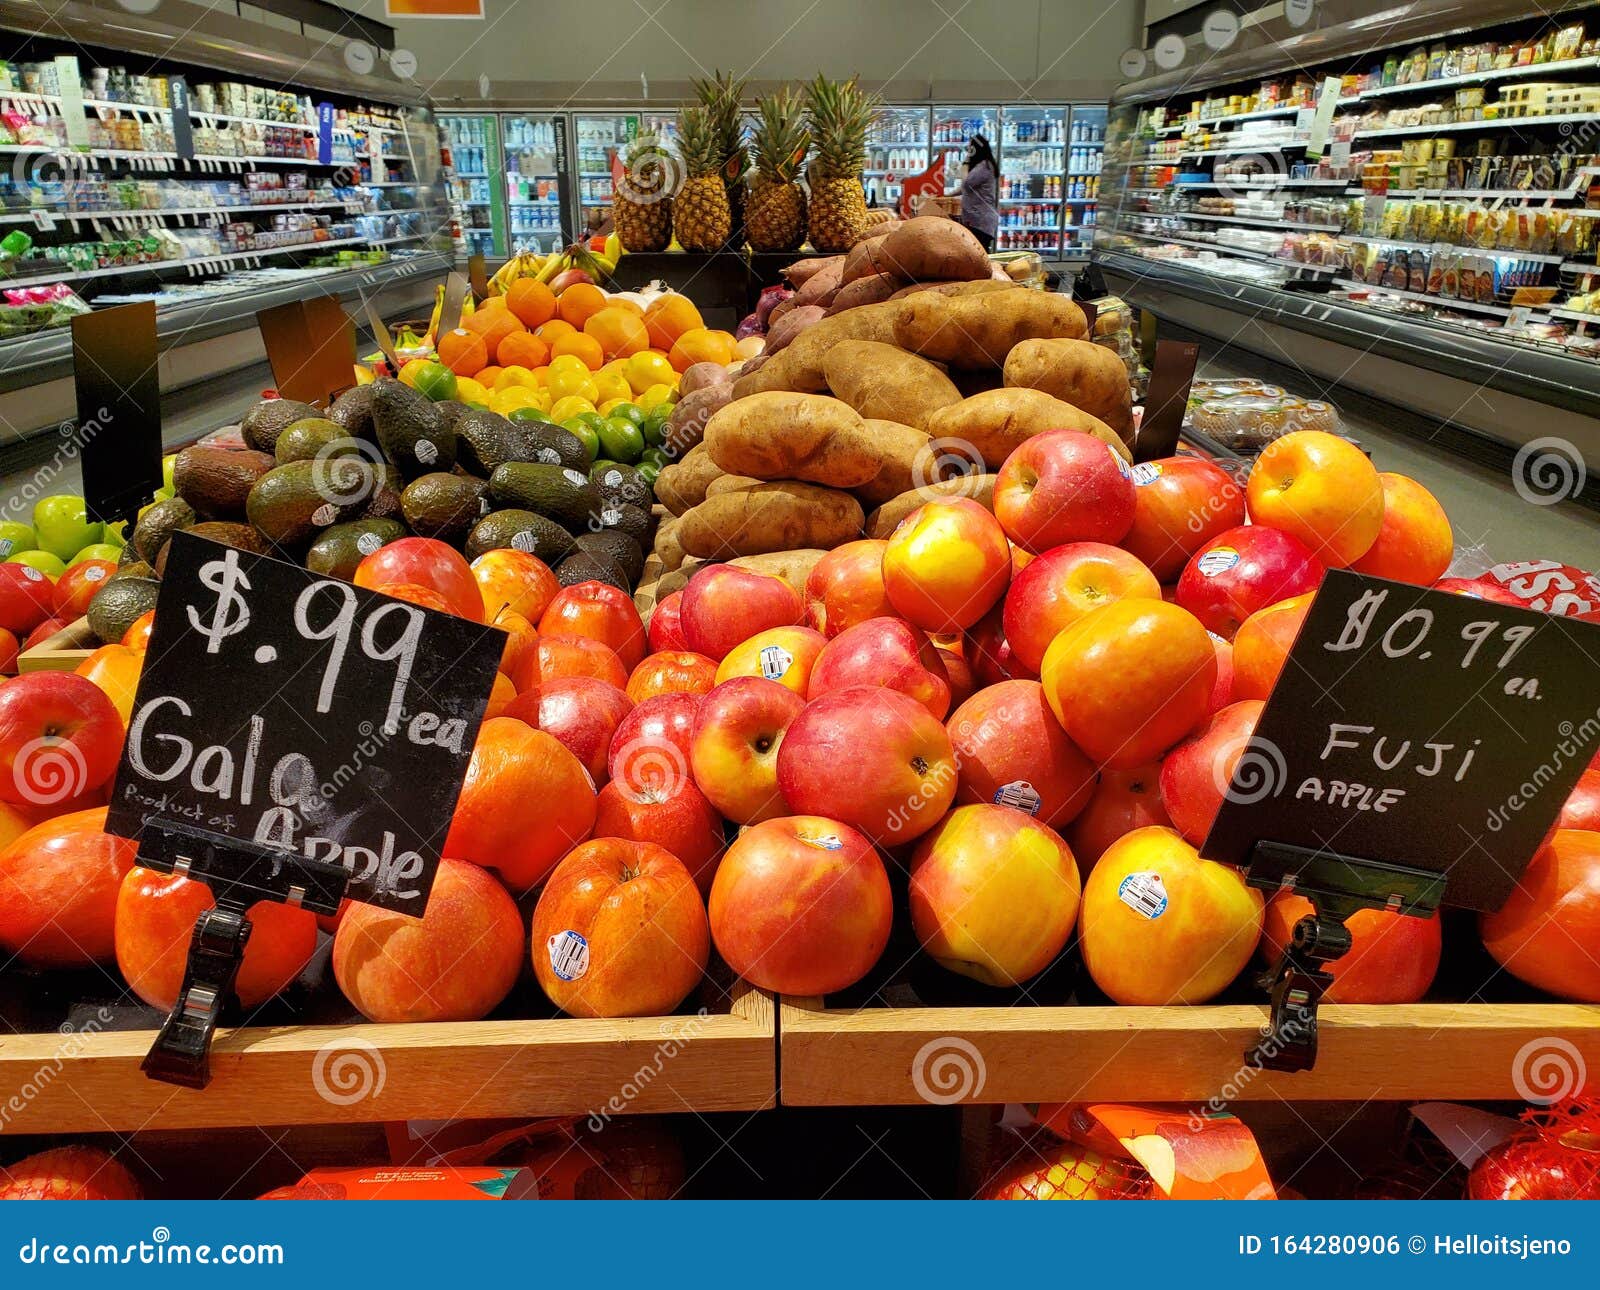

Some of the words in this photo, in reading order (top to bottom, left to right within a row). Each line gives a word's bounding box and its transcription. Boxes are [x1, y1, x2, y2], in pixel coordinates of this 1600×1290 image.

[186, 549, 426, 736] $.99
[407, 712, 471, 754] ea
[1323, 589, 1536, 669] $0.99
[128, 696, 322, 812] Gala
[207, 814, 238, 833] of
[1295, 777, 1407, 813] APPLE
